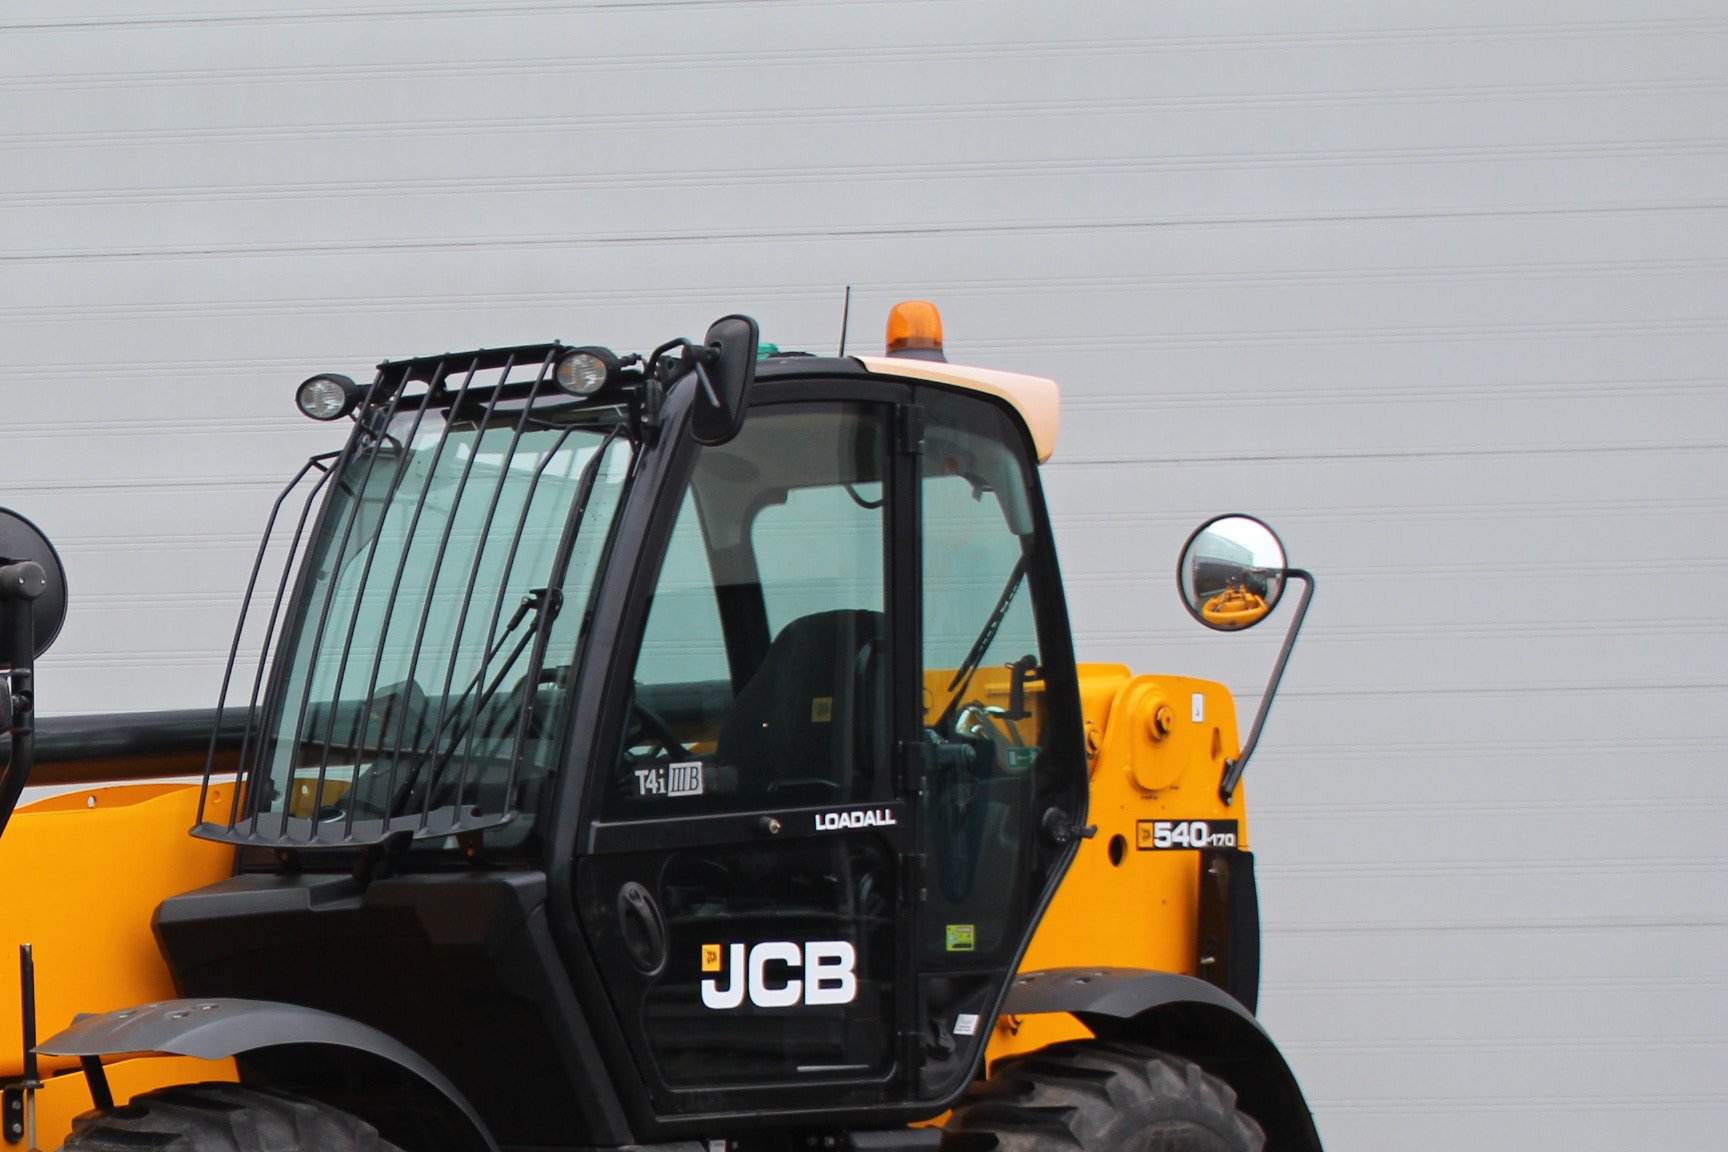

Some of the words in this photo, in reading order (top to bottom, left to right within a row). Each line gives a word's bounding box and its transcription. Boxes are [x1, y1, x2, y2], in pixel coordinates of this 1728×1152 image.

[635, 768, 666, 795] T4i
[815, 809, 896, 830] LOADALL
[701, 941, 856, 1009] JCB
